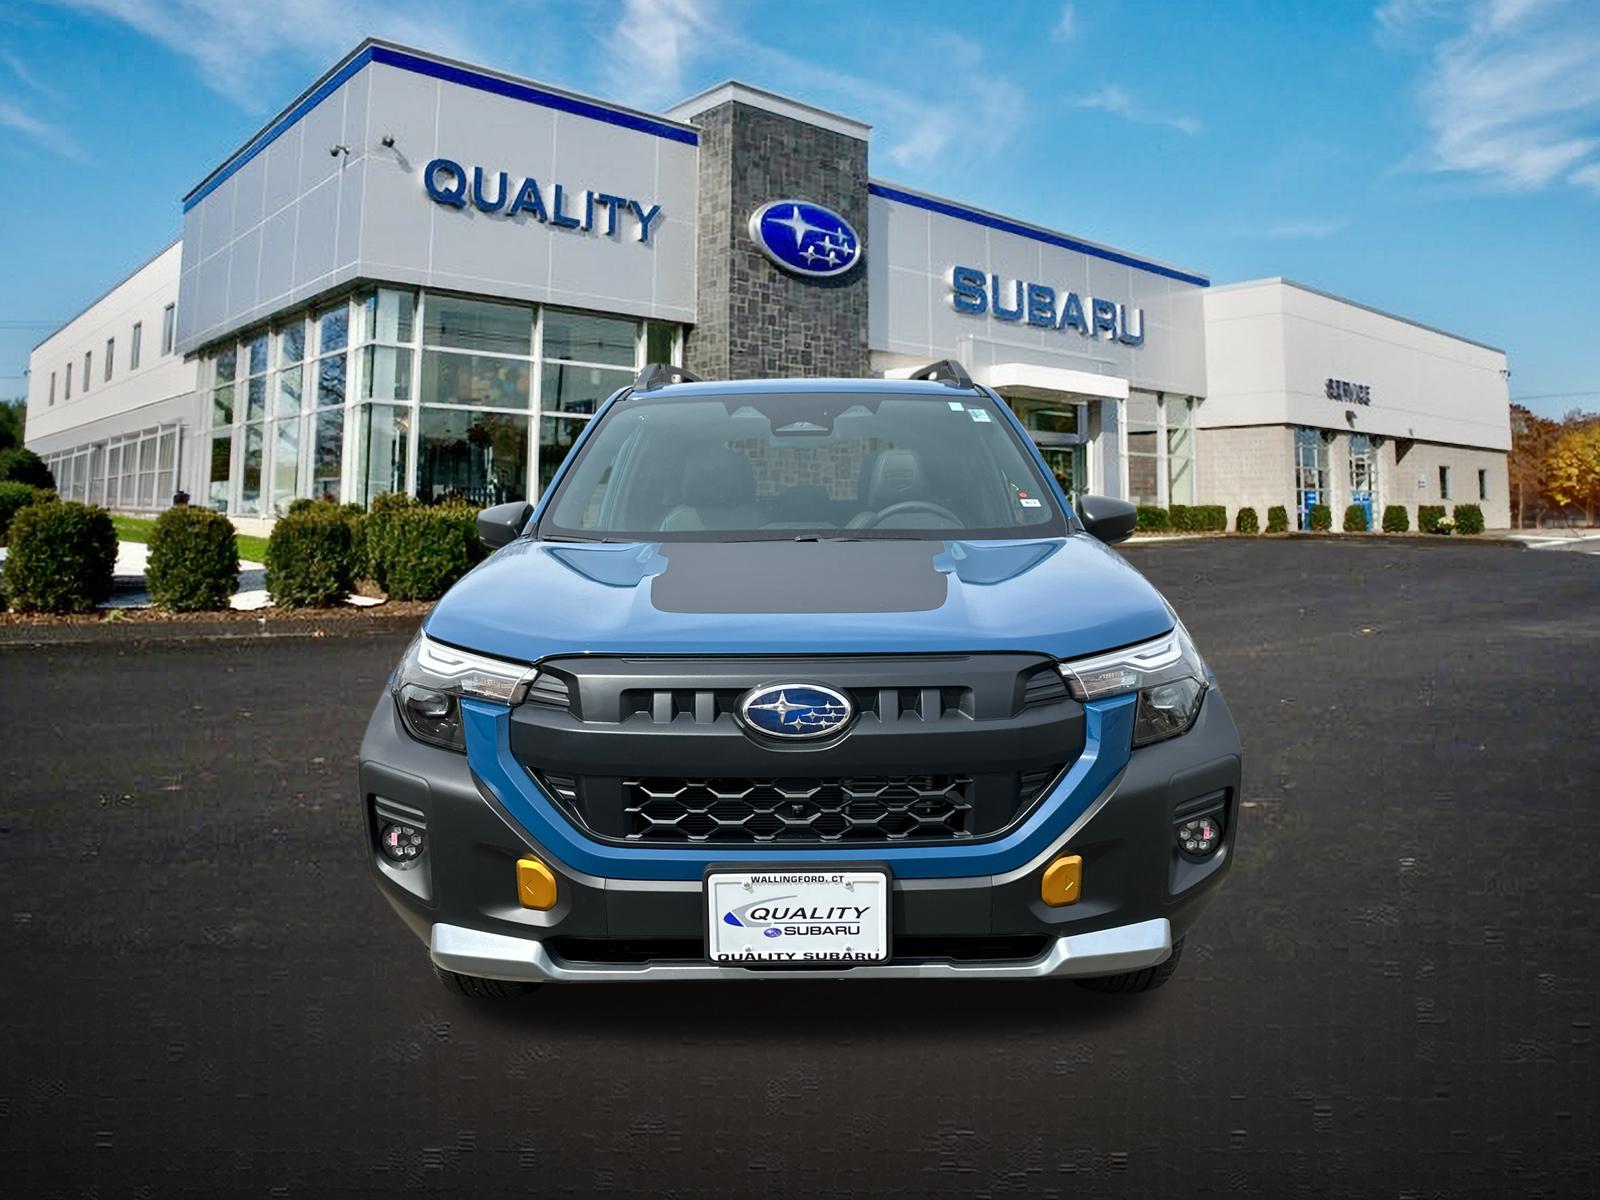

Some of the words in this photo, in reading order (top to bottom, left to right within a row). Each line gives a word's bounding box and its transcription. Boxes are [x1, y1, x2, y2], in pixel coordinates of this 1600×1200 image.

[424, 158, 661, 242] QUALITY
[951, 265, 1144, 346] SUBARU
[1325, 378, 1371, 406] SERVICE
[831, 875, 844, 884] CT
[750, 906, 871, 921] QUALITY
[784, 926, 860, 935] SUBARU
[717, 952, 796, 961] QUALITY
[803, 952, 879, 961] SUBARU
